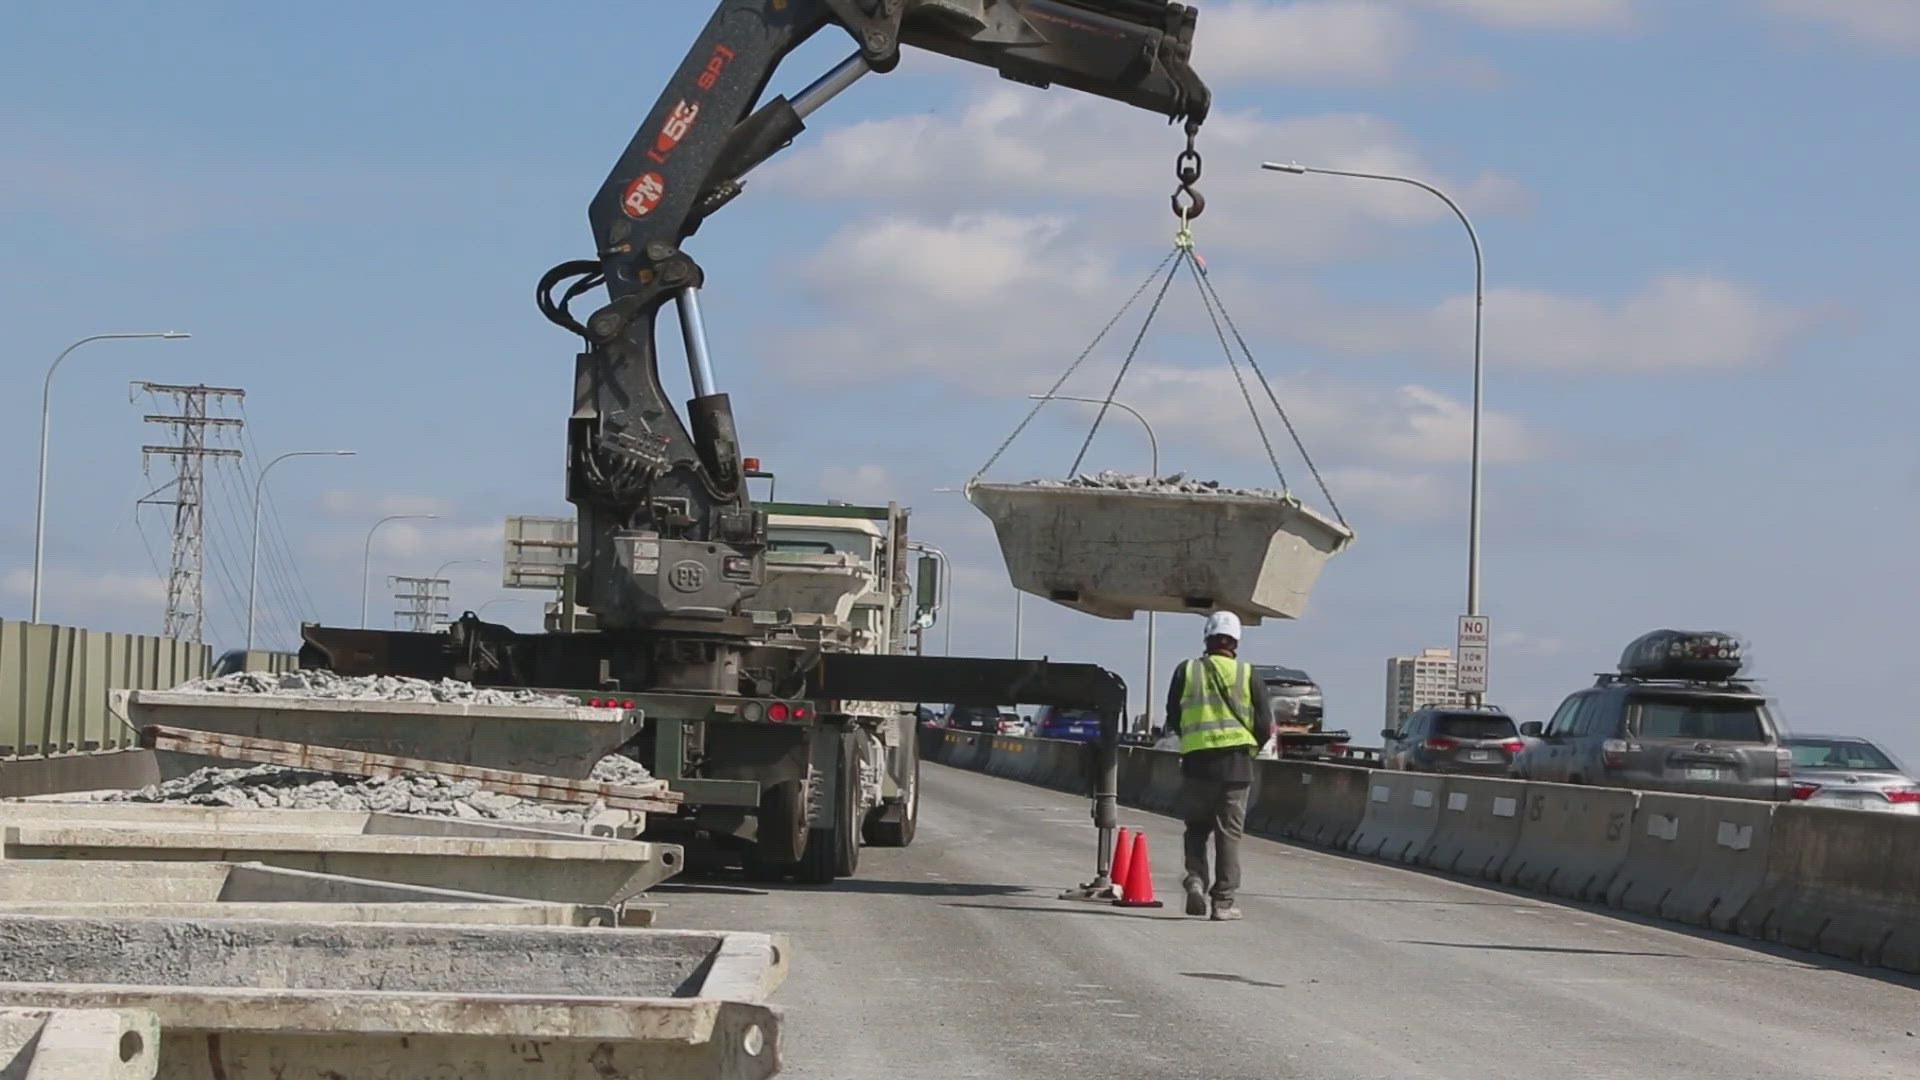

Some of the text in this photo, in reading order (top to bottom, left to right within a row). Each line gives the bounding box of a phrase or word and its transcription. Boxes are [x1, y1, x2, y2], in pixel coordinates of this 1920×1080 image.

[625, 174, 665, 215] PM
[677, 568, 702, 586] PM
[1464, 622, 1483, 633] NO
[1464, 653, 1481, 661] TOW
[1460, 665, 1484, 673] AWAY
[1460, 676, 1483, 685] ZONE
